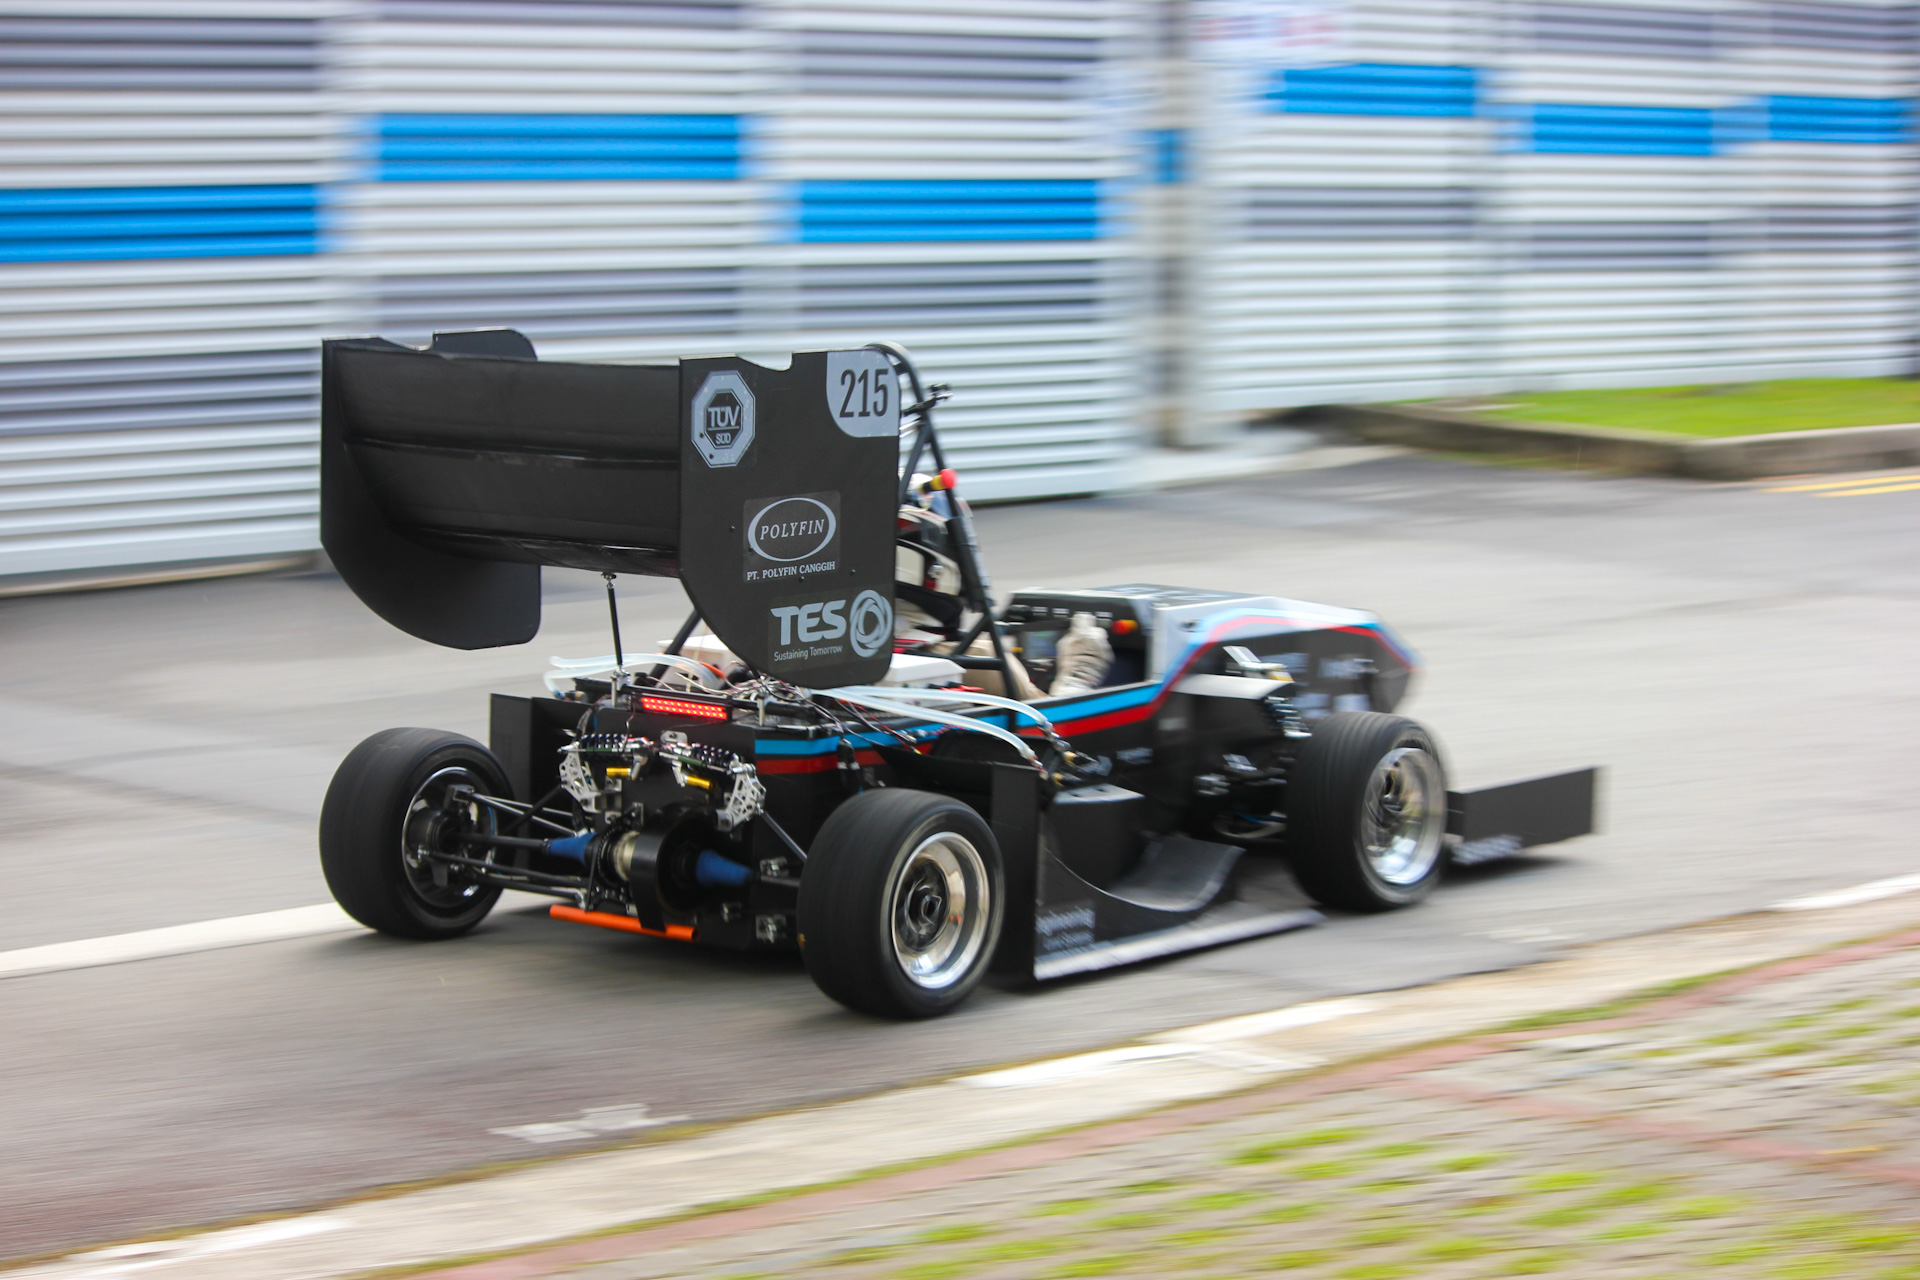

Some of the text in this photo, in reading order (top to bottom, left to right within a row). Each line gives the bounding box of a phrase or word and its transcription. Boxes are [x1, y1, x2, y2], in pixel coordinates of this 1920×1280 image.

[839, 369, 889, 418] 215
[707, 404, 740, 428] TÜV
[760, 519, 825, 540] POLYFIN
[746, 561, 836, 581] PT. POLYFIN CANGGIH
[770, 600, 847, 646] TES
[774, 645, 843, 662] Sustaining Tomorrow
